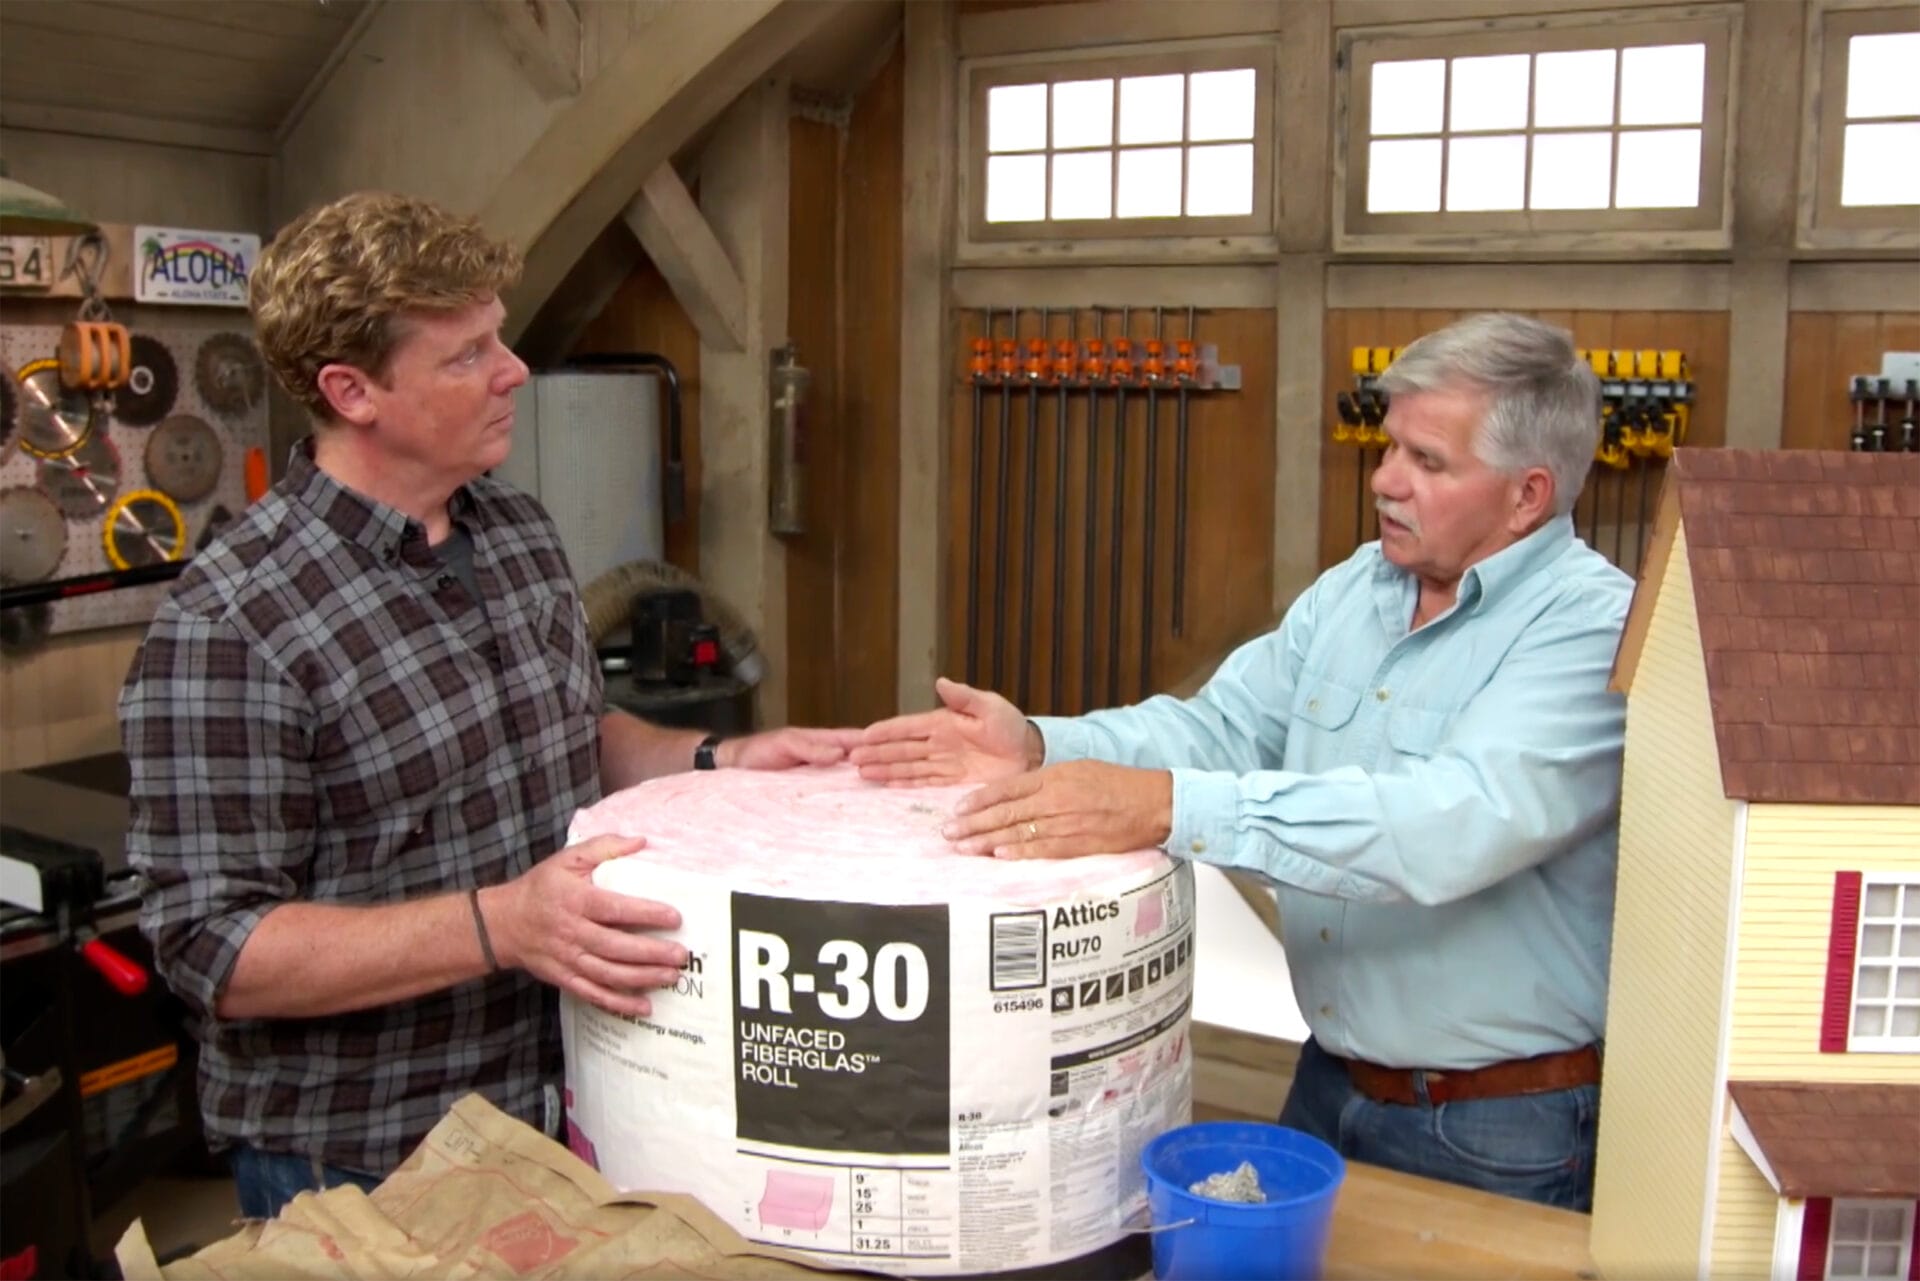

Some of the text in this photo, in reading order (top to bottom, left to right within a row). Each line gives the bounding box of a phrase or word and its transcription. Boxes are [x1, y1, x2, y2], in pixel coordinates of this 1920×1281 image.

[150, 246, 249, 285] ALOHA
[1052, 899, 1120, 930] Attics
[1052, 935, 1102, 961] RU70
[738, 929, 930, 1021] R-30
[637, 1018, 666, 1036] energy
[740, 1020, 846, 1051] UNFACED
[742, 1061, 799, 1089] ROLL
[856, 1239, 891, 1250] 31.25
